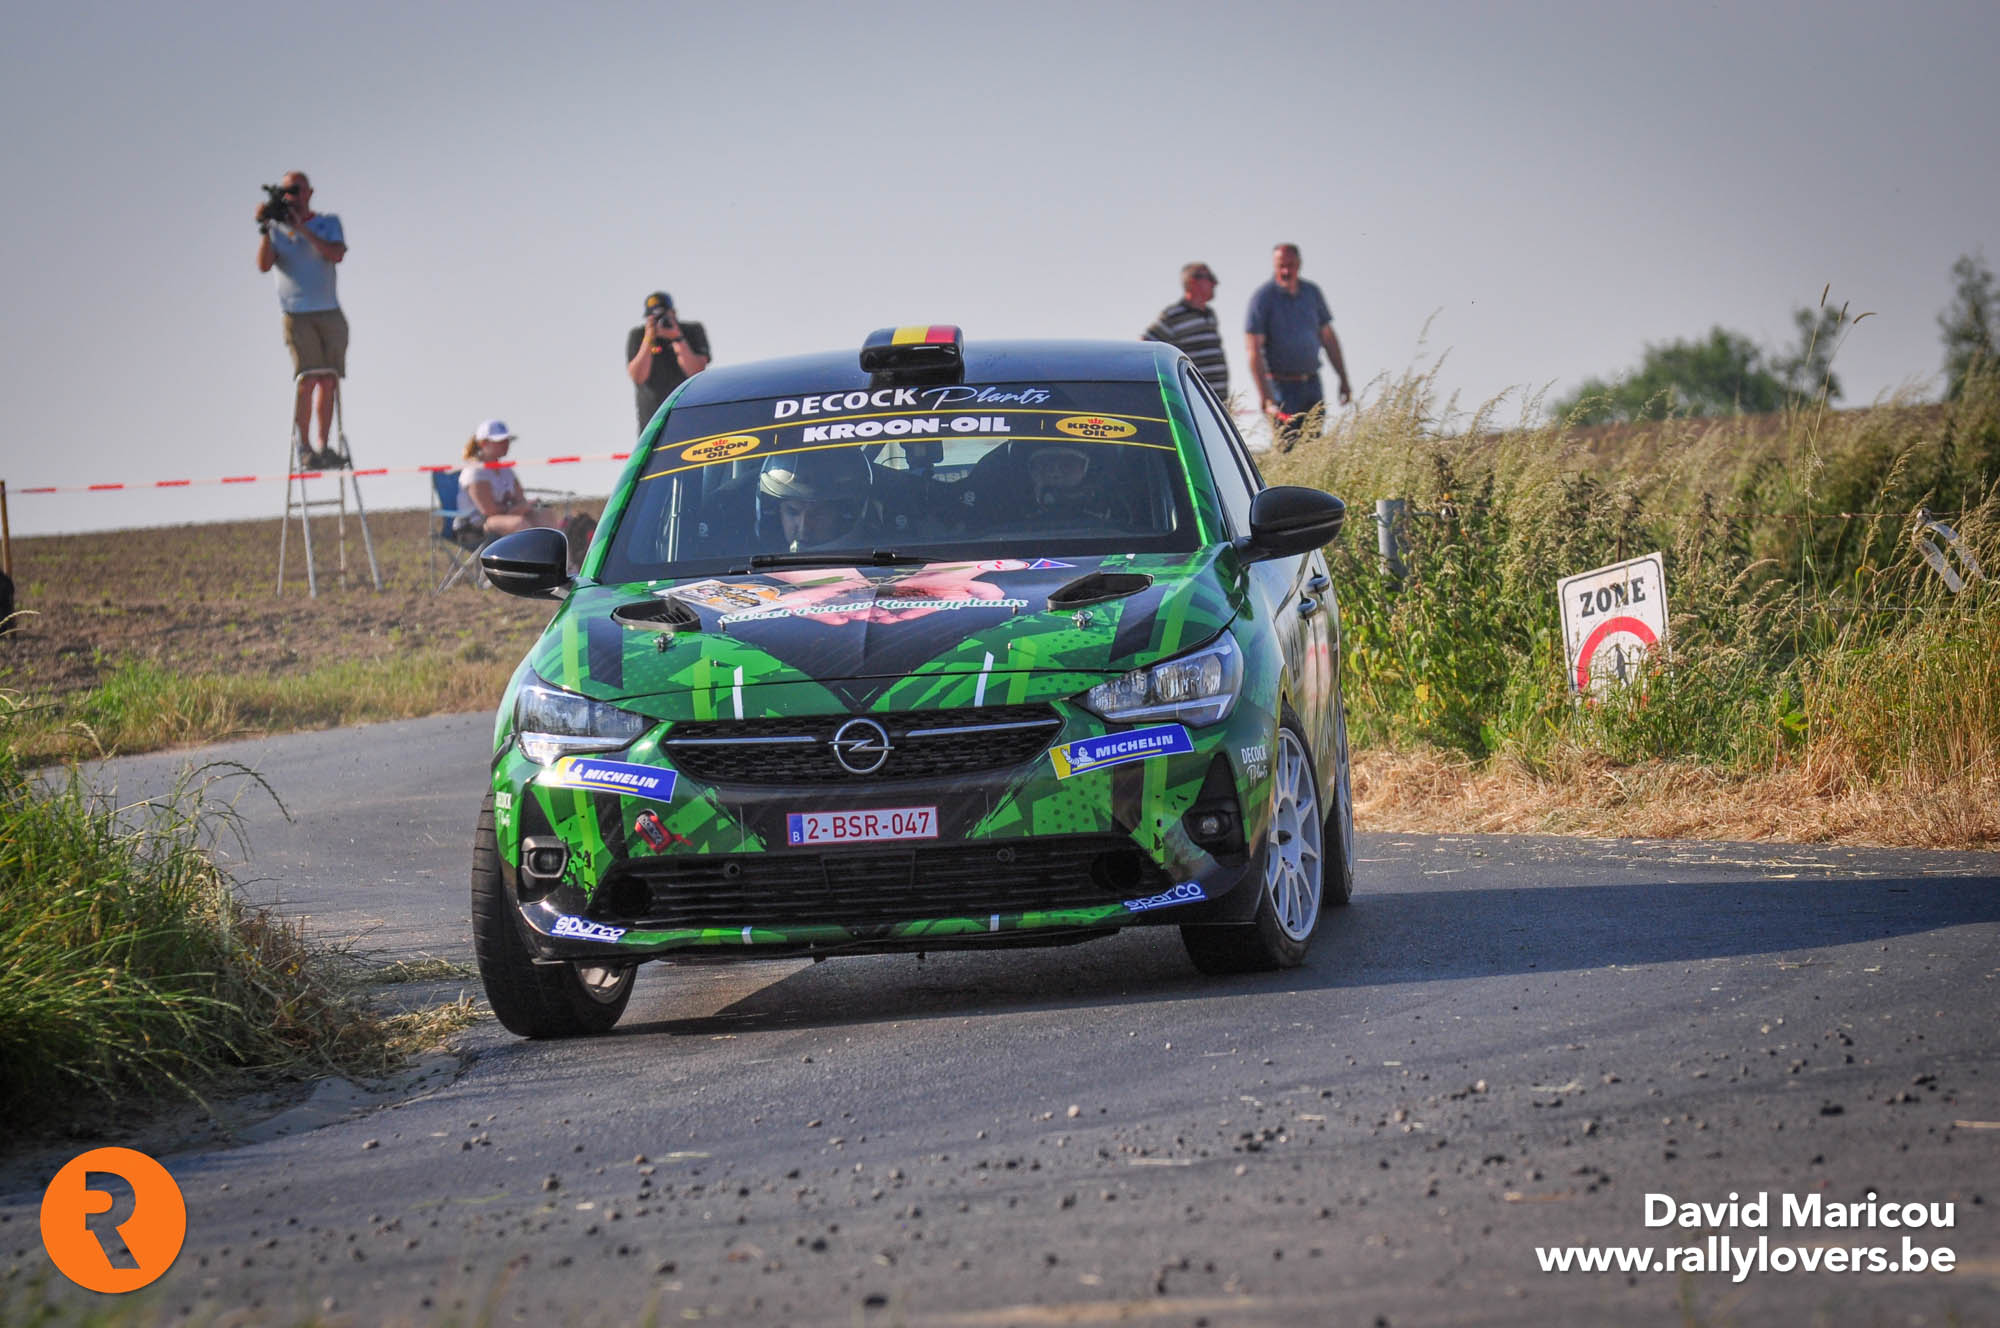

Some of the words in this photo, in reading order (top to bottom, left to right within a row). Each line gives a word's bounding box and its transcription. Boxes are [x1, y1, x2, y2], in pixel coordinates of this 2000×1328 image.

[774, 387, 919, 419] DECOCK
[921, 386, 1051, 411] Plants
[802, 416, 1011, 443] KROON-OIL
[1067, 421, 1126, 433] KROON
[1082, 429, 1108, 437] OIL
[692, 440, 749, 457] KROON
[706, 449, 731, 459] OIL
[1579, 576, 1647, 618] ZONE
[1095, 734, 1174, 758] MICHELIN
[583, 768, 660, 789] MICHELIN
[792, 831, 801, 842] B
[807, 811, 930, 840] 2-BSR-047
[1123, 882, 1202, 910] sparco
[554, 915, 627, 936] sparco
